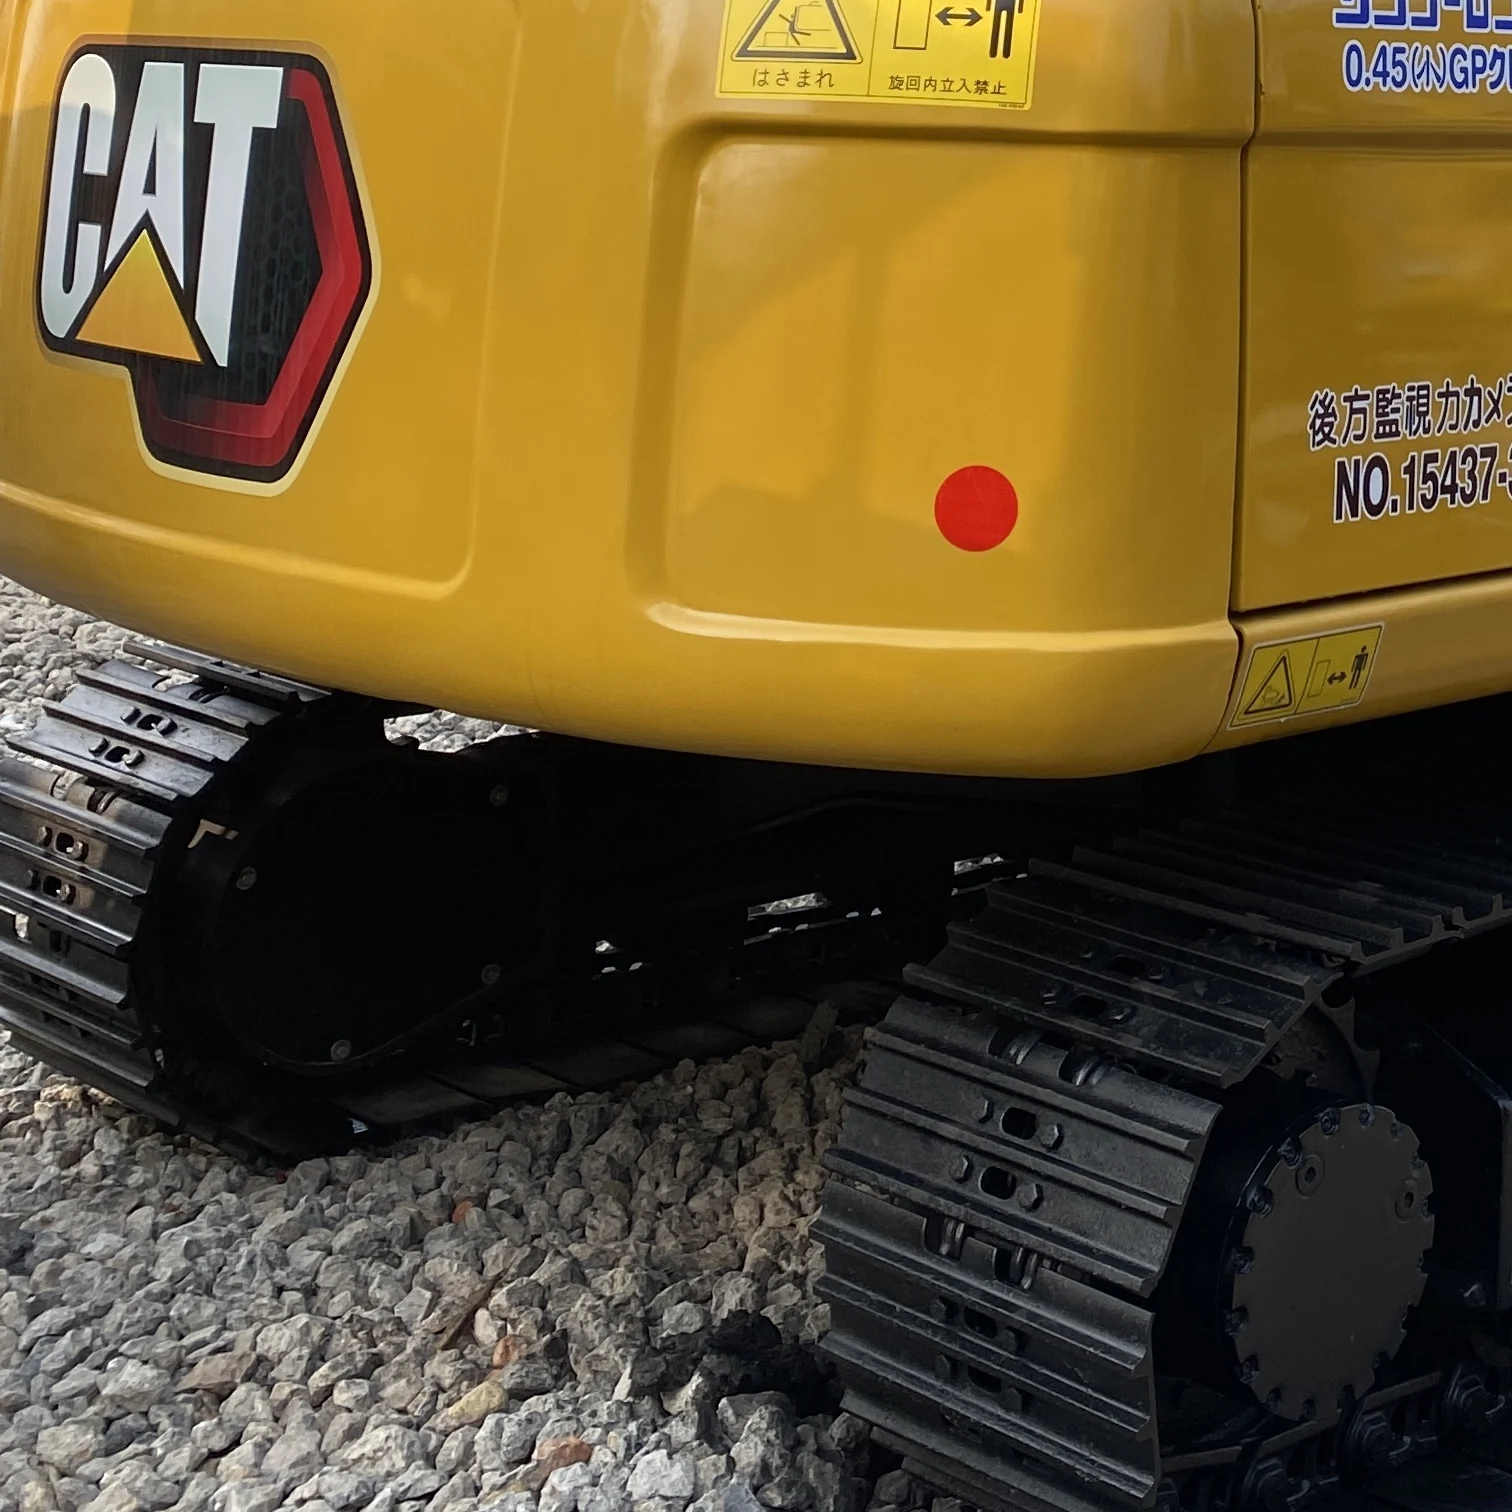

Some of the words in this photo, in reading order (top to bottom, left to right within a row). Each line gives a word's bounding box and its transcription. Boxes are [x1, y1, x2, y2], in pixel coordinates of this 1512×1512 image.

[751, 68, 835, 89] はさまれ
[887, 74, 1008, 96] 旋回内立入禁止
[41, 53, 284, 368] CAT
